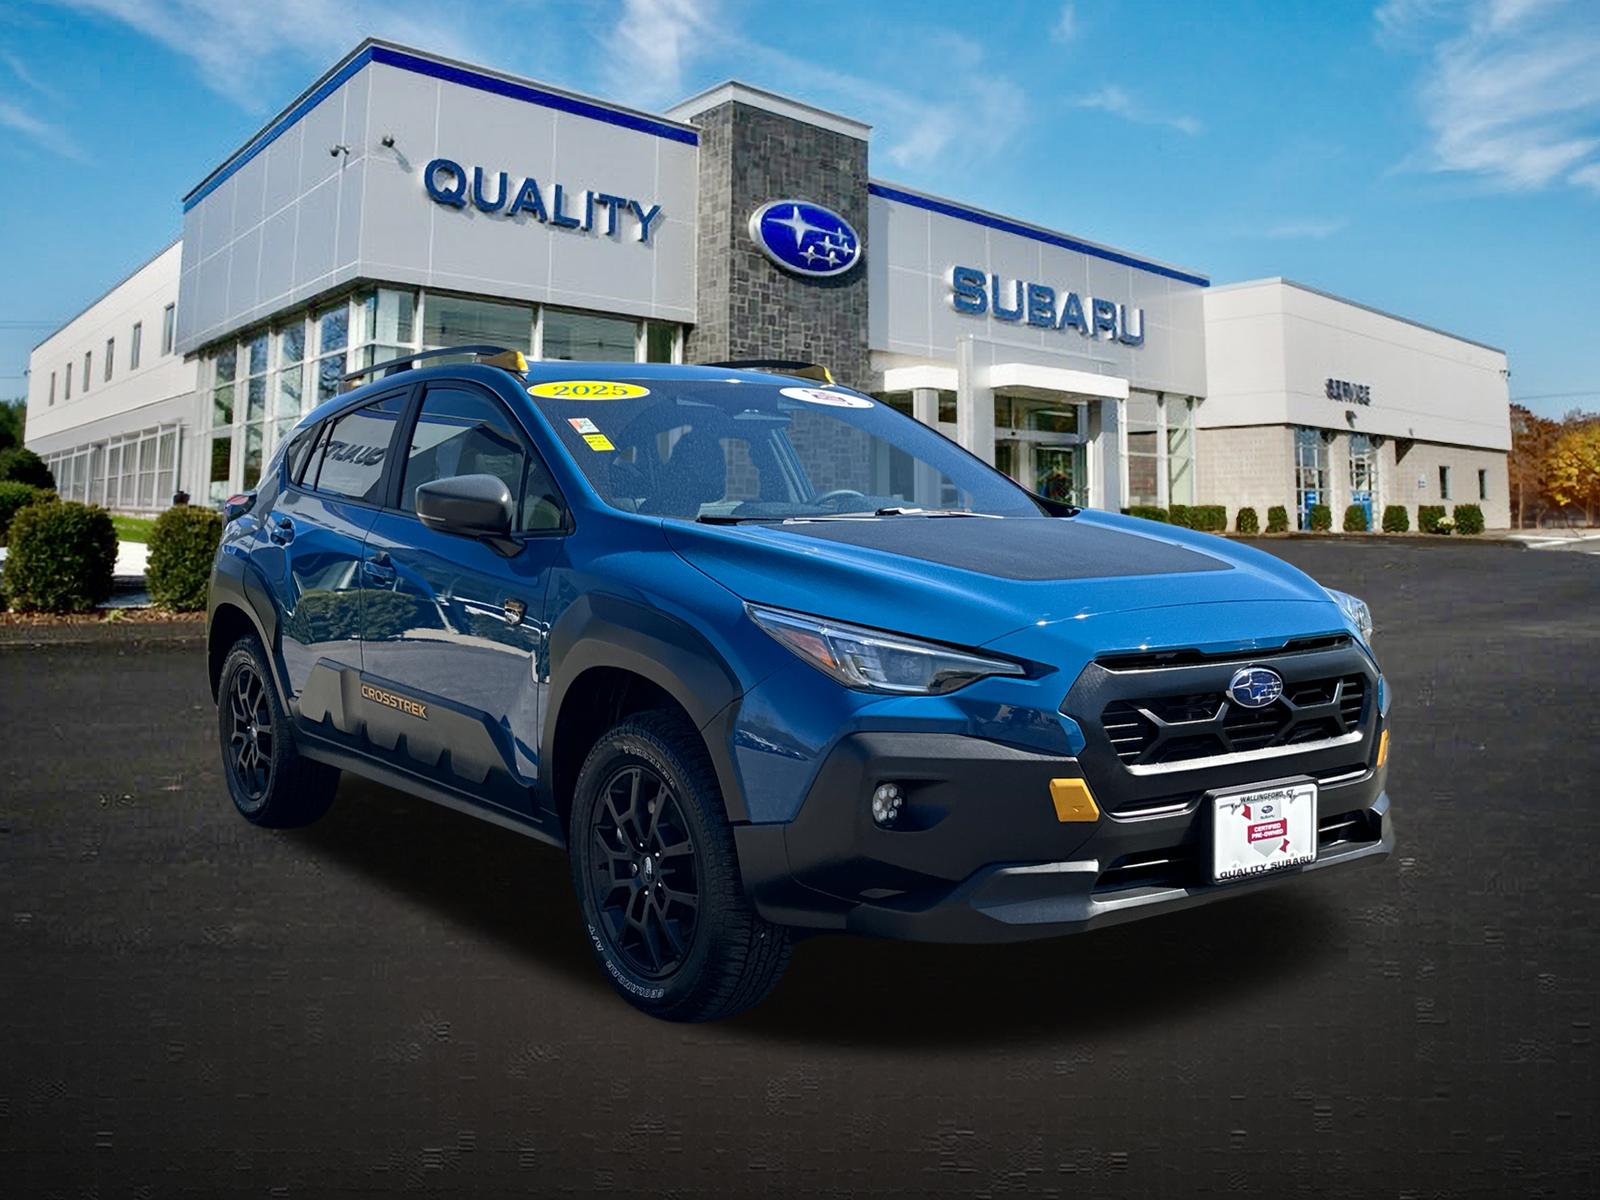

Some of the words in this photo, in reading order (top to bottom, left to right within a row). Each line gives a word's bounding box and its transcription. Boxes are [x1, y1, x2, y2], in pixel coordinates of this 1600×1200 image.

[423, 158, 662, 244] QUALITY
[946, 264, 1145, 347] SUBARU
[553, 384, 628, 396] 2025
[361, 683, 428, 719] CROSSTREK
[1220, 863, 1267, 879] QUALITY
[1269, 854, 1314, 871] SUBARU
